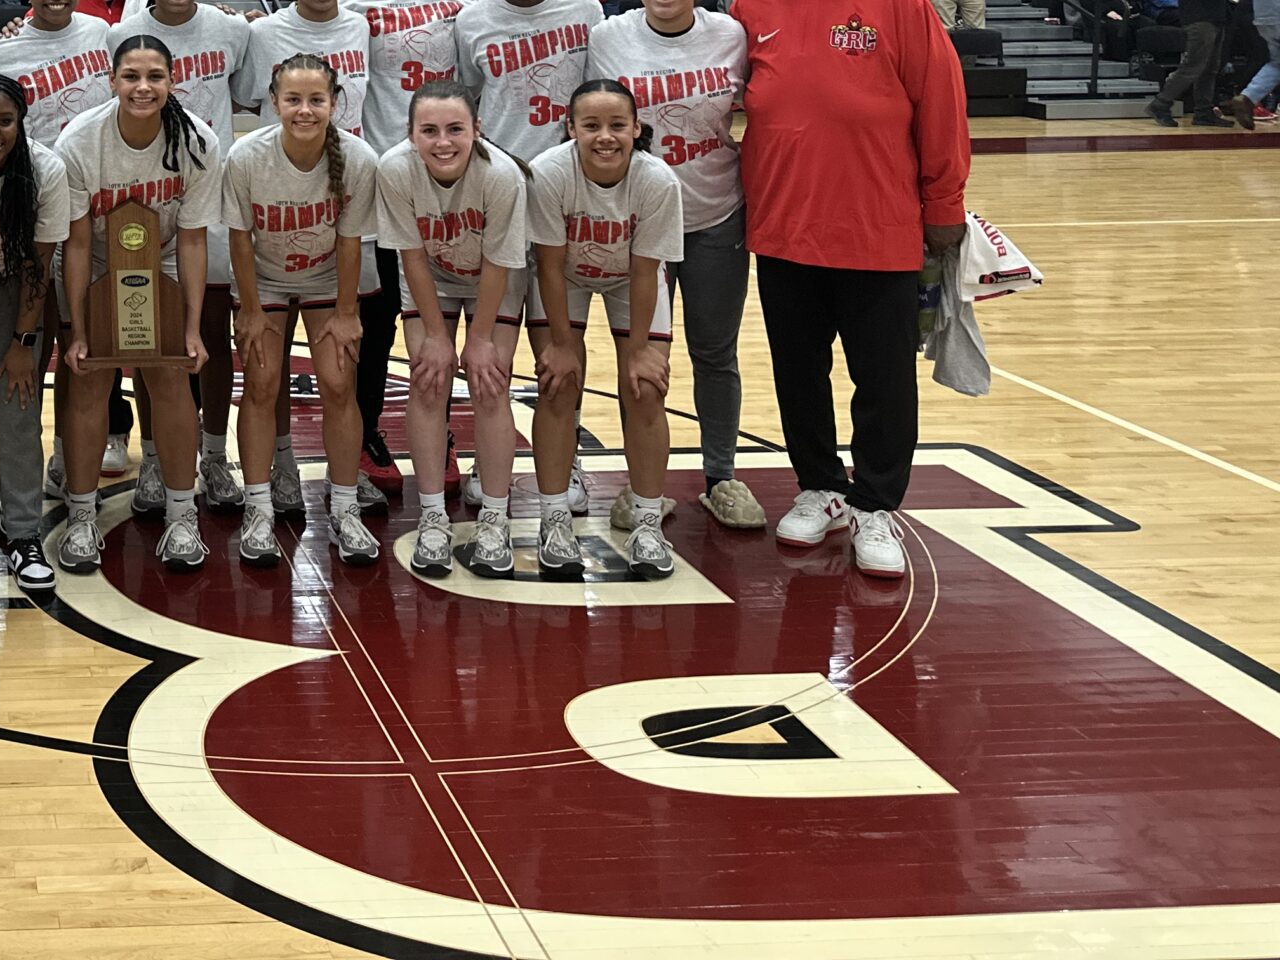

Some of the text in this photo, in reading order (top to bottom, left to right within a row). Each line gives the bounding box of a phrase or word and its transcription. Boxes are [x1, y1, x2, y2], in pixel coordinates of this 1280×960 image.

[486, 23, 589, 78] CHAMPIONS
[829, 30, 877, 51] GRC
[18, 49, 113, 106] CHAMPIONS
